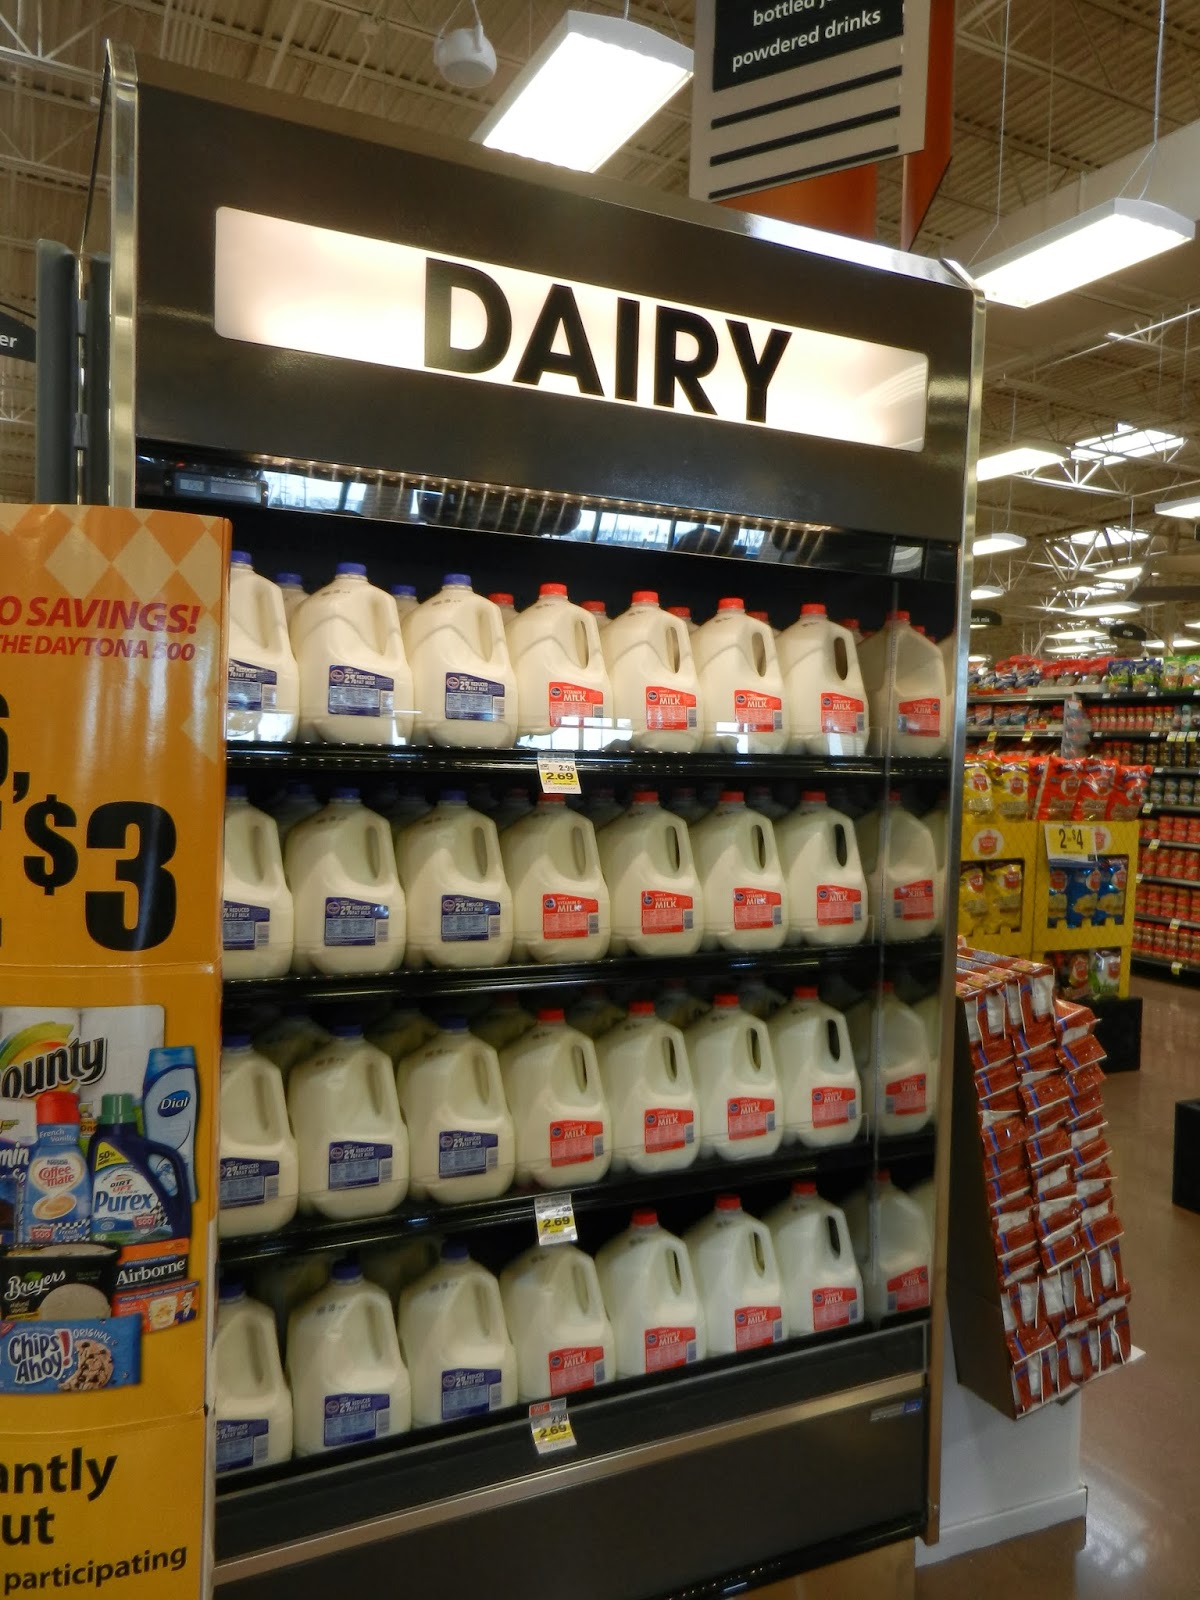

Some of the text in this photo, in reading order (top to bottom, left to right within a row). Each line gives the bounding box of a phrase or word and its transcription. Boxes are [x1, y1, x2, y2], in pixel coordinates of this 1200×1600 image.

[732, 10, 882, 72] powdered drinks
[424, 257, 793, 423] DAIRY
[26, 597, 200, 634] SAVINGS!
[35, 635, 148, 659] DAYTONA
[152, 642, 195, 661] 500
[563, 694, 586, 702] MILK
[546, 772, 574, 780] 2.69
[1059, 829, 1067, 848] 2
[655, 901, 676, 909] MILK
[2, 1037, 107, 1098] ounty
[160, 1097, 188, 1110] Dial
[740, 1105, 760, 1115] MILK
[658, 1118, 678, 1126] MILK
[40, 1129, 64, 1139] French
[564, 1129, 586, 1139] MILK
[39, 1166, 73, 1181] Coffee
[47, 1174, 75, 1187] mate
[110, 1179, 132, 1188] DIRT
[94, 1191, 153, 1213] Purex
[543, 1216, 570, 1228] 2.69
[116, 1258, 186, 1285] Airborne
[4, 1270, 66, 1300] Breyers
[748, 1313, 767, 1325] MILK
[73, 1328, 111, 1343] ORIGINAL
[659, 1335, 680, 1346] MILK
[564, 1355, 586, 1368] MILK
[539, 1424, 567, 1438] 2.69
[4, 1546, 188, 1595] participating
